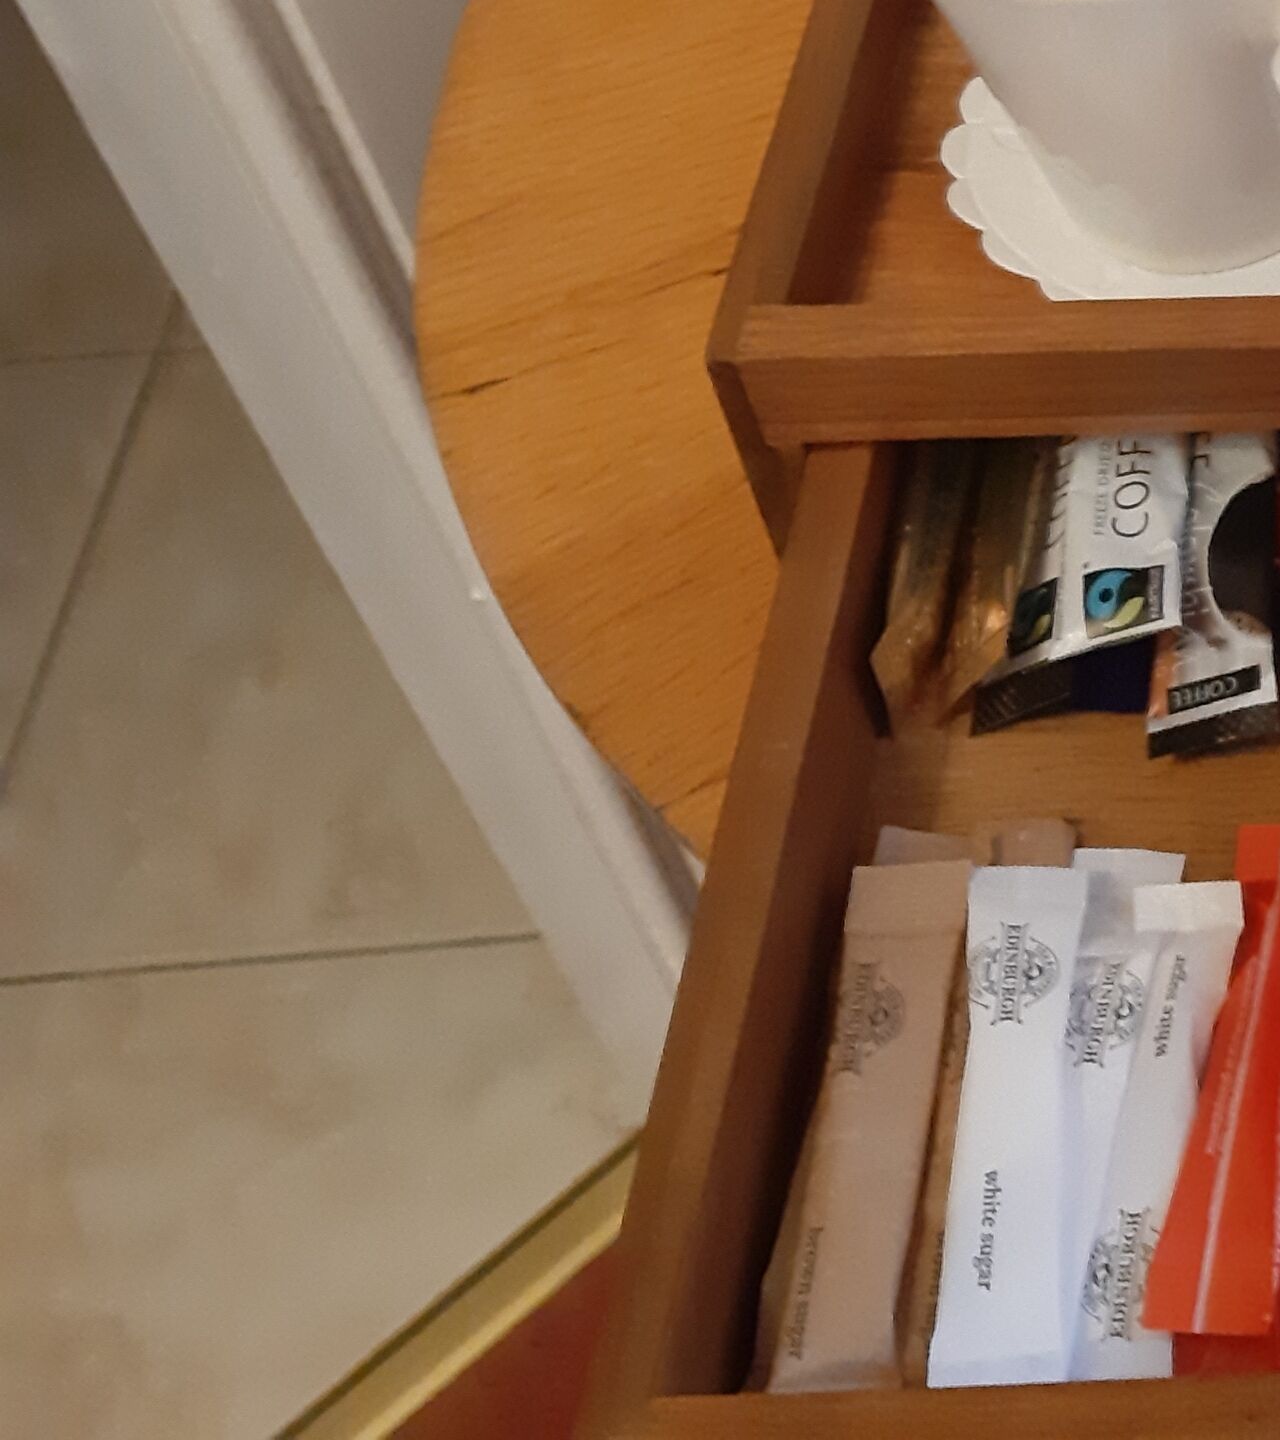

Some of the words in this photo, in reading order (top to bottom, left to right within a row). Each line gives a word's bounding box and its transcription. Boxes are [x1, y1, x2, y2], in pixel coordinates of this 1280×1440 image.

[1000, 923, 1022, 1023] EDINBURGH
[981, 1169, 1003, 1228] white
[971, 1232, 995, 1292] sugar
